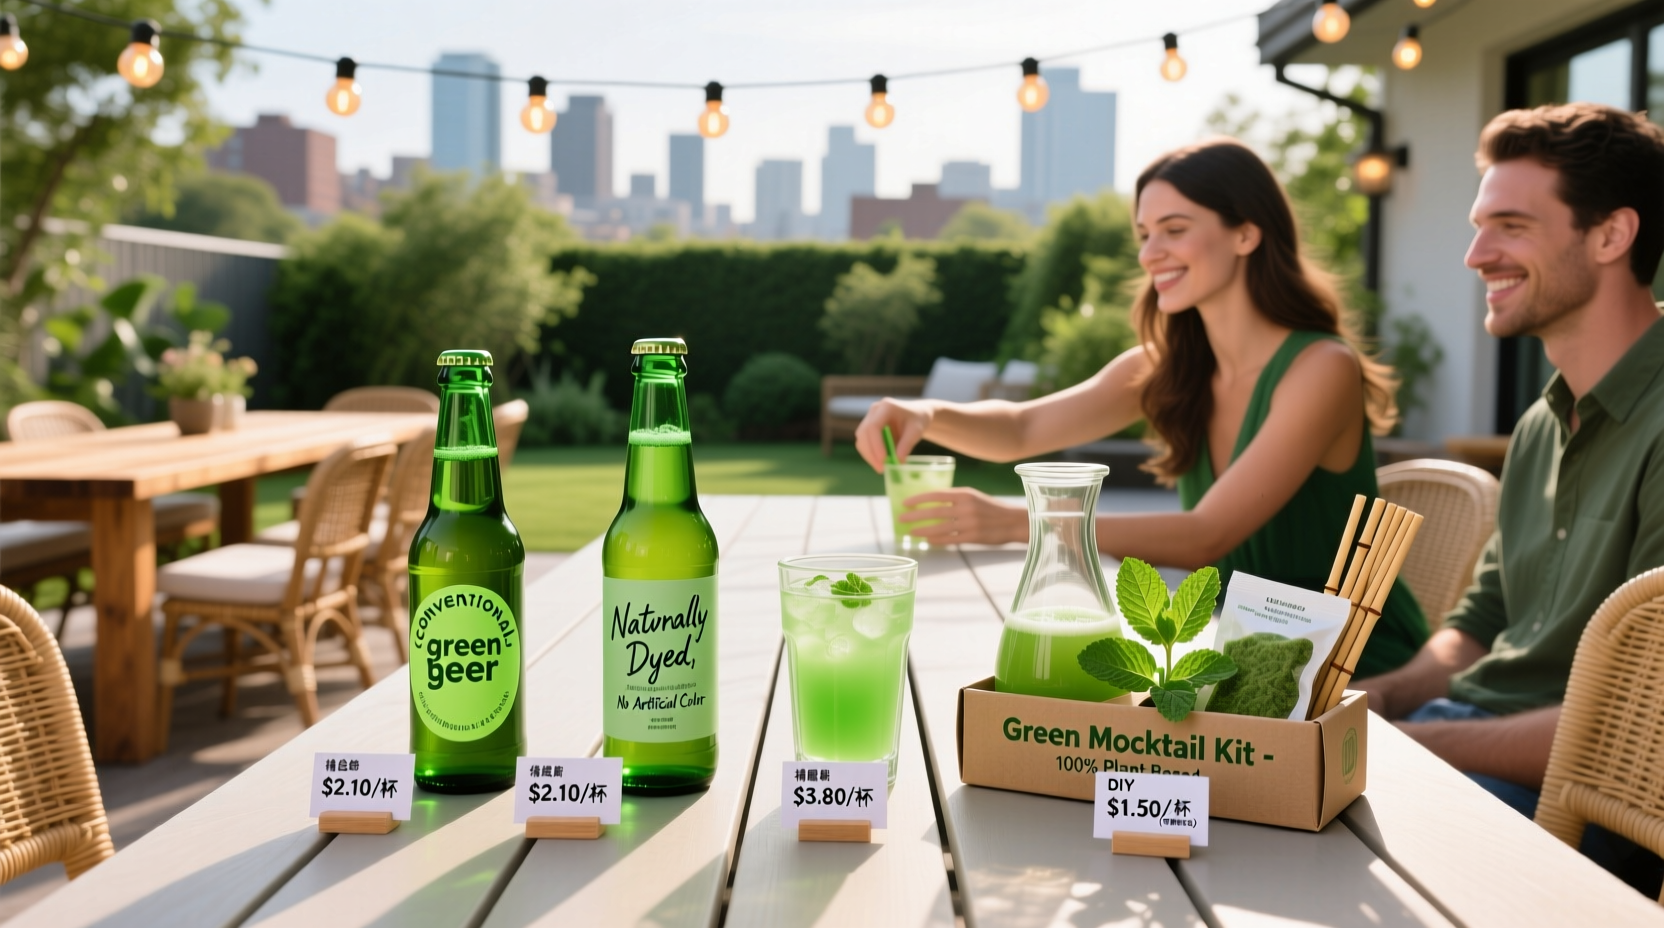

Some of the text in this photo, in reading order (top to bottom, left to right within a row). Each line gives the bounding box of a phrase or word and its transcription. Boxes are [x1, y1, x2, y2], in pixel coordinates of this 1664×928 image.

[611, 594, 708, 643] Naturally
[427, 637, 501, 662] green
[626, 634, 695, 685] Dyed,
[617, 695, 629, 710] No
[1002, 717, 1080, 748] Green
[1089, 725, 1204, 761] Mocktail
[1215, 737, 1255, 767] Kit
[1056, 755, 1097, 775] 100%
[321, 776, 398, 799] $2.10/杯
[528, 782, 607, 804] $2.10/杯
[1108, 778, 1135, 792] DIY
[793, 786, 874, 808] $3.80/杯
[1107, 797, 1191, 819] $1.50/杯
